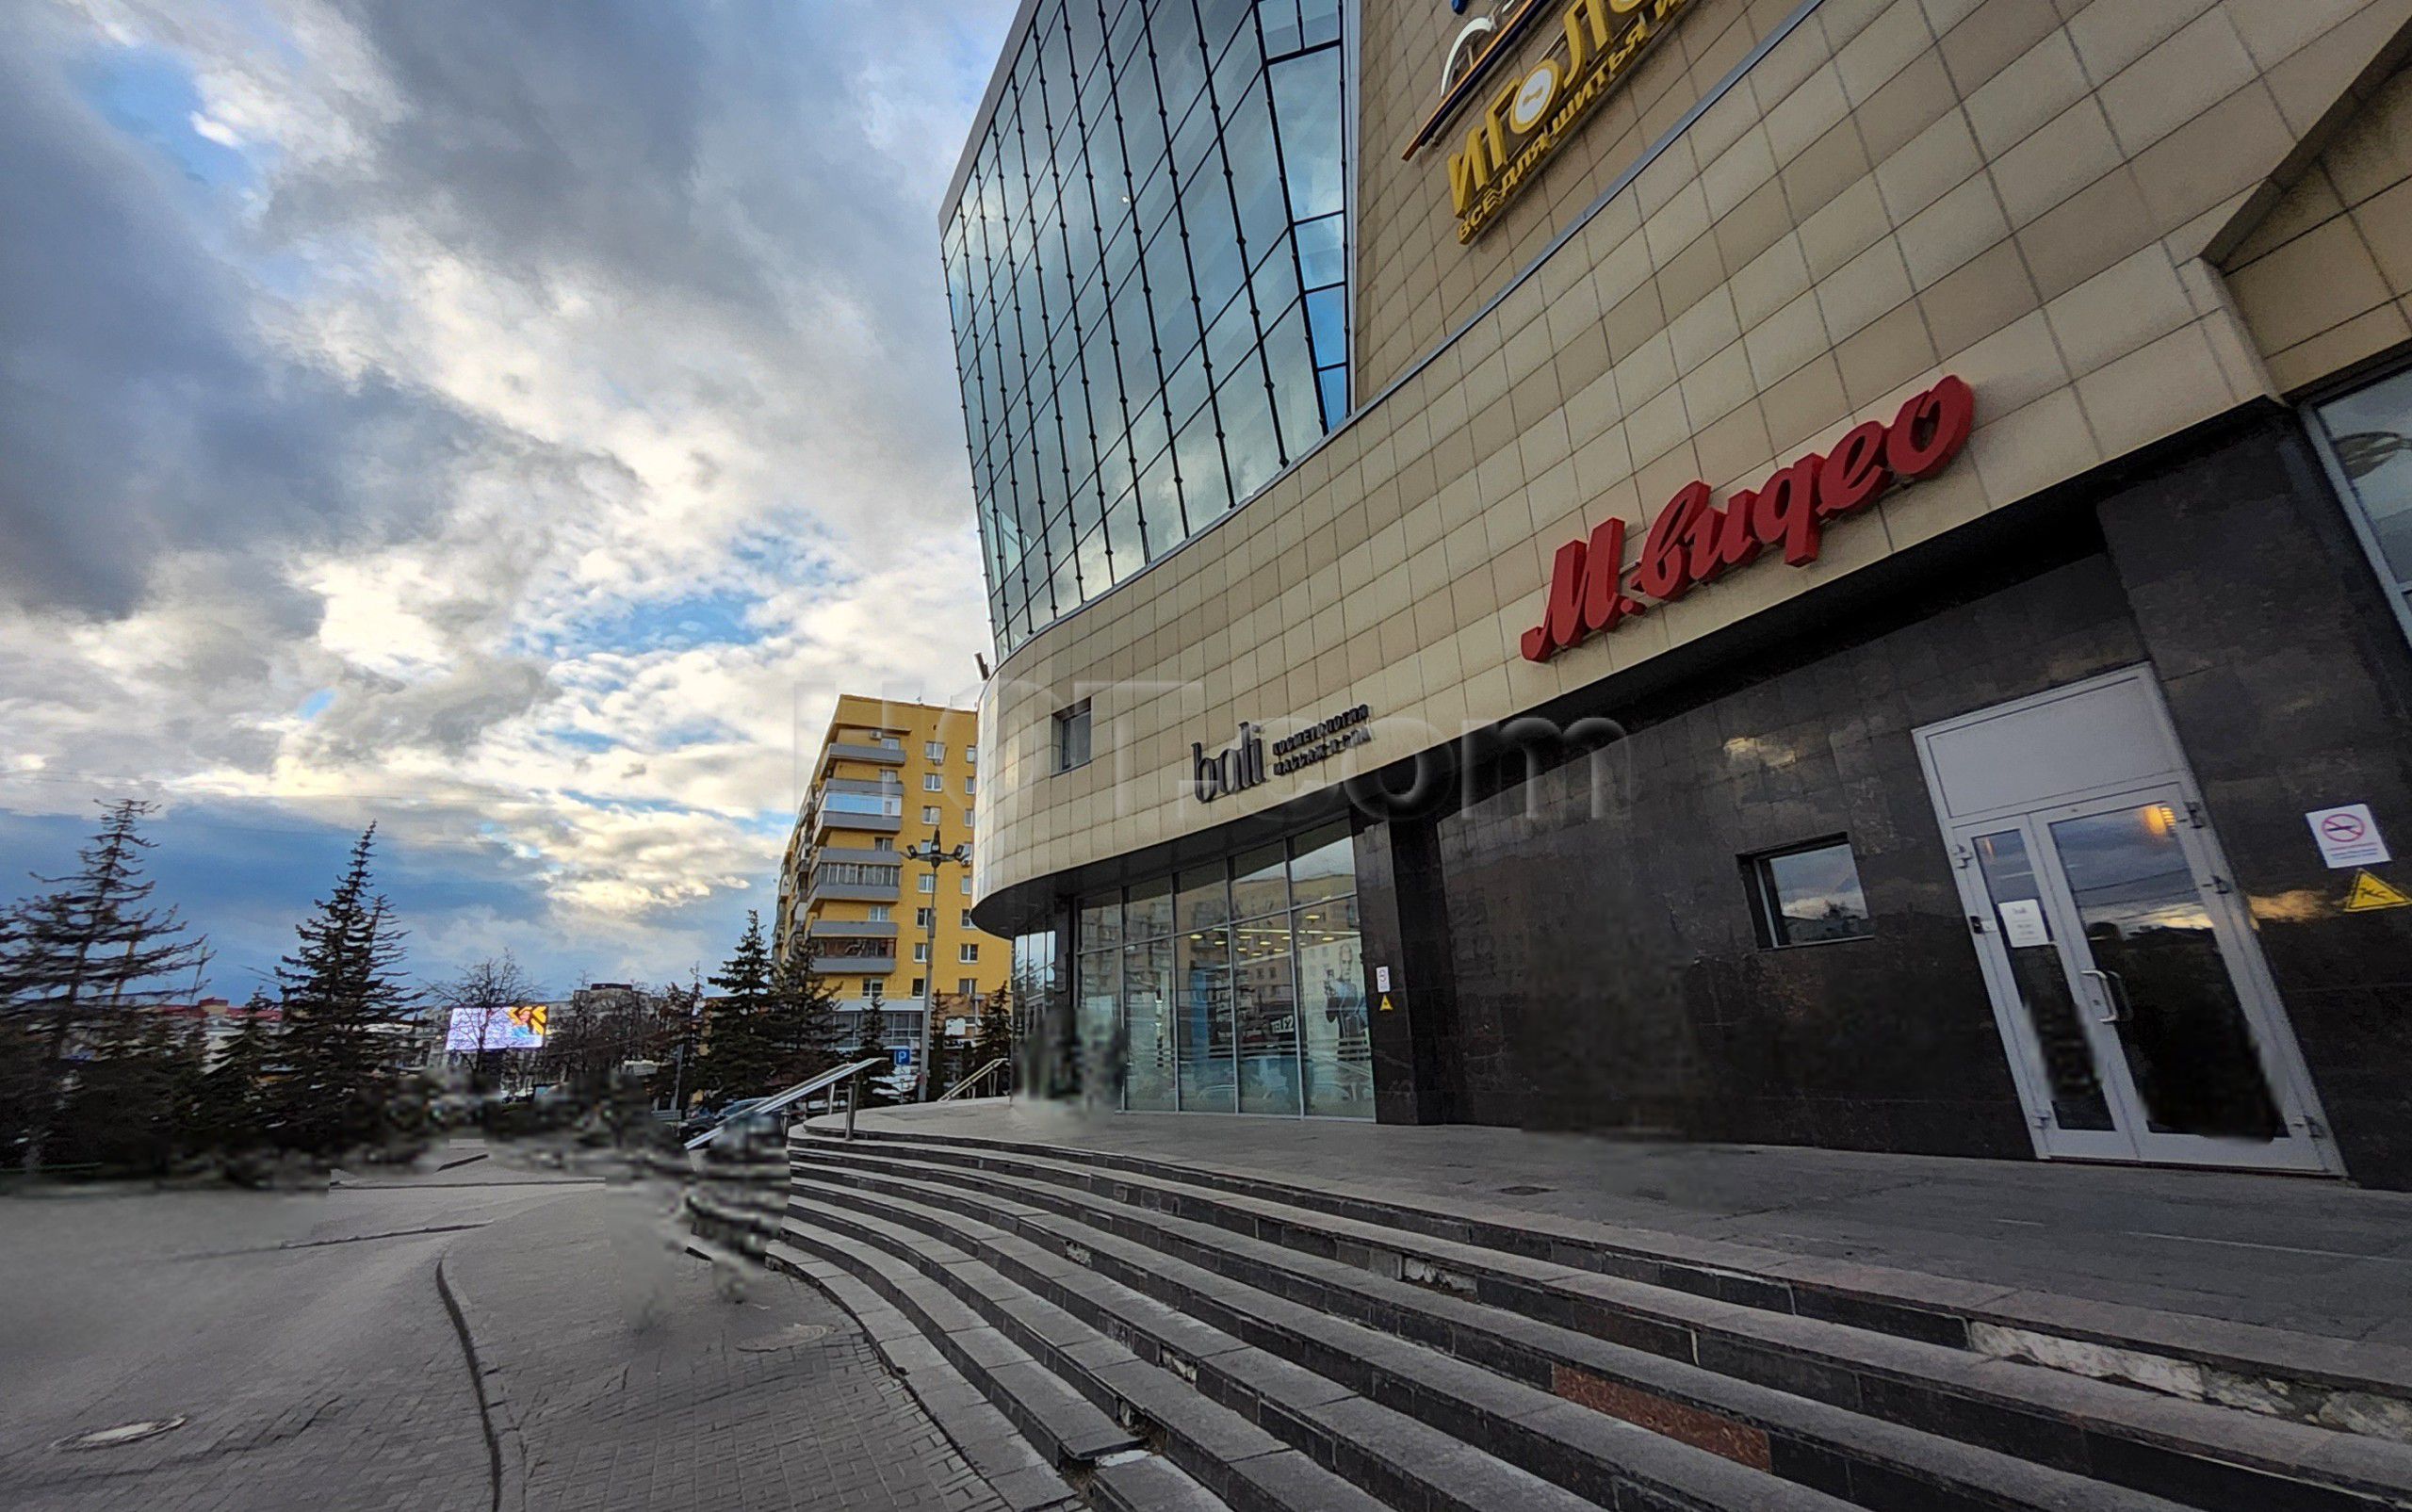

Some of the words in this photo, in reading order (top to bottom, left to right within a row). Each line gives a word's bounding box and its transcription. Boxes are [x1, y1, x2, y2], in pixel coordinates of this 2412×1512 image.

[1448, 0, 1645, 219] ИГОЛ
[1191, 721, 1266, 804] bali
[898, 1050, 907, 1064] P
